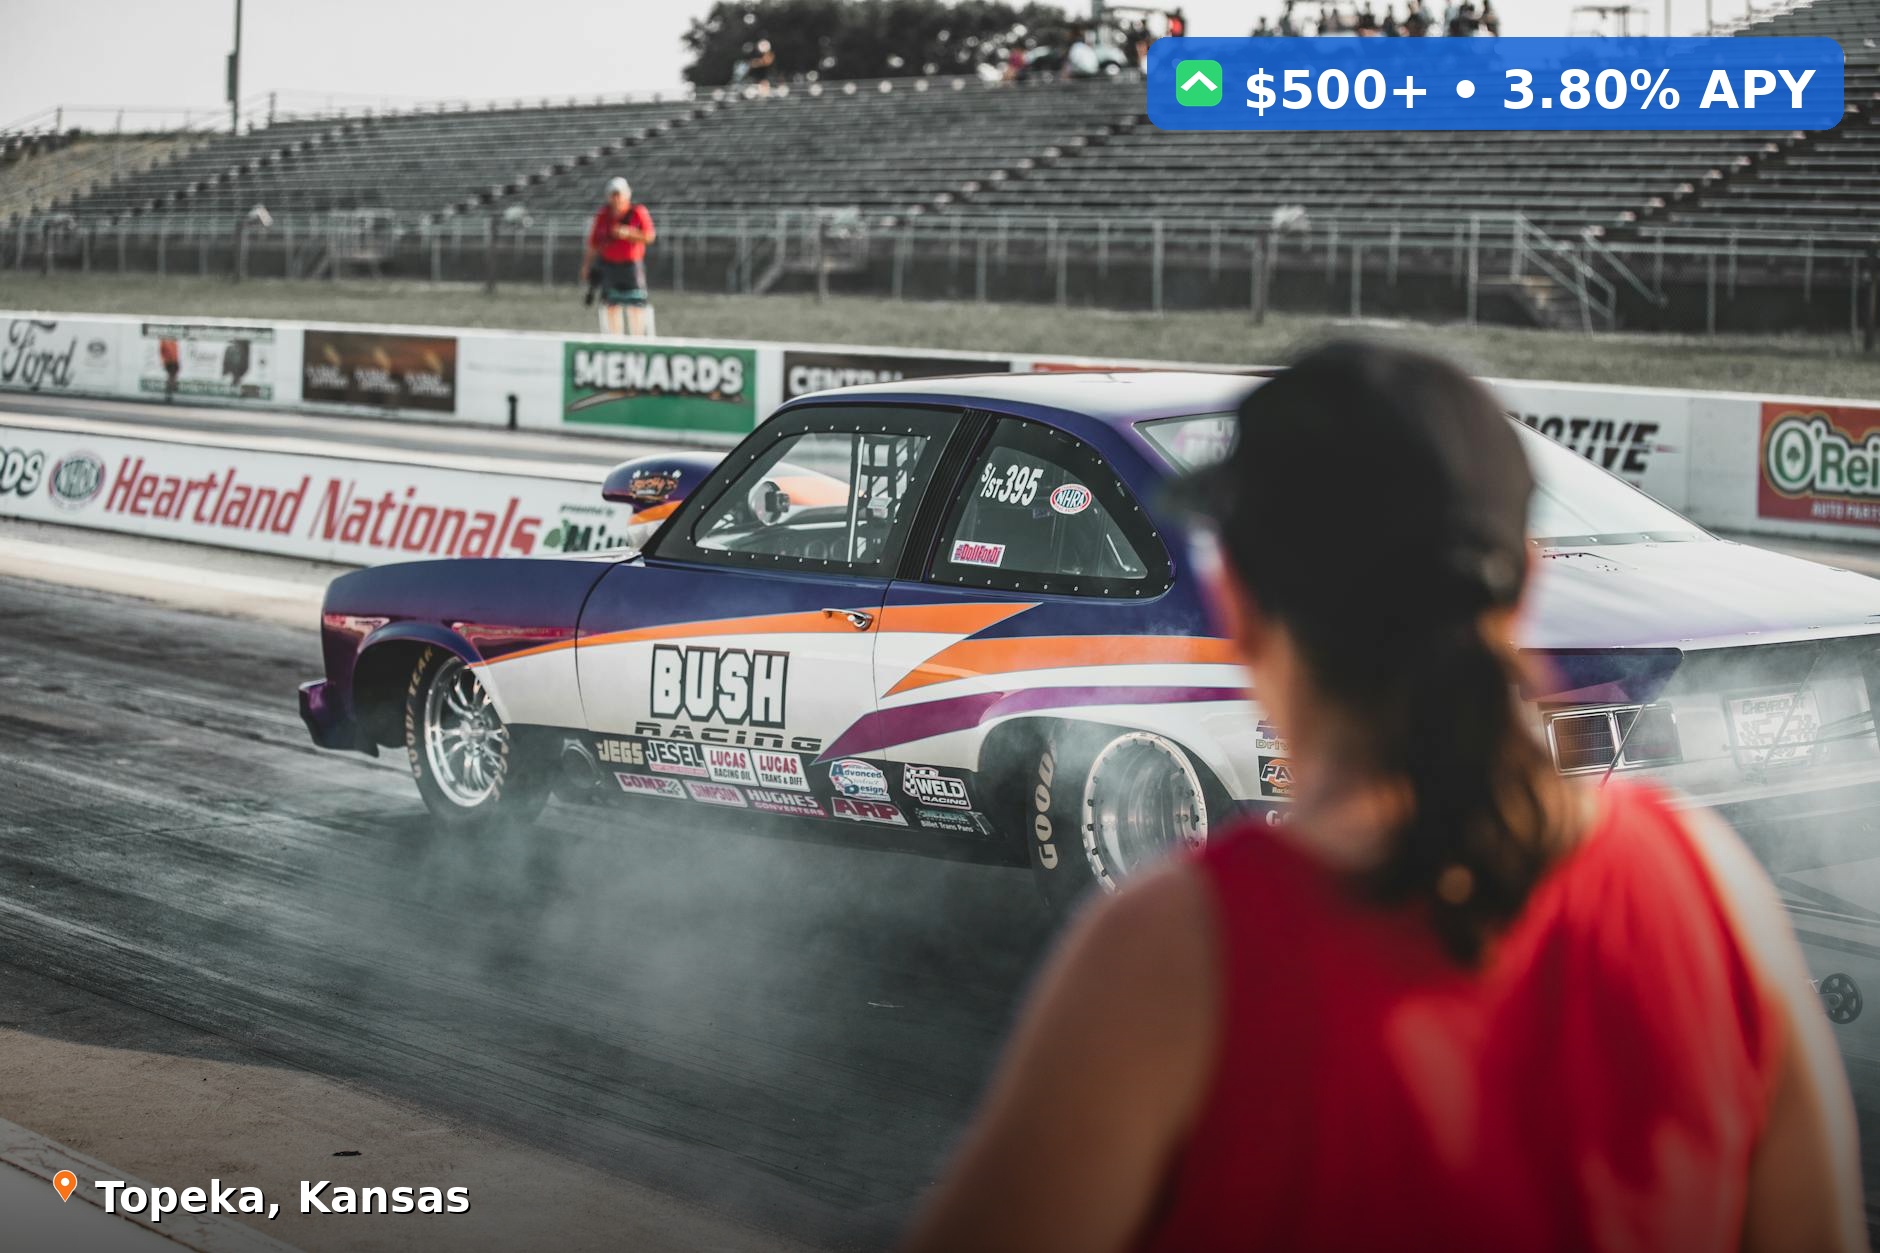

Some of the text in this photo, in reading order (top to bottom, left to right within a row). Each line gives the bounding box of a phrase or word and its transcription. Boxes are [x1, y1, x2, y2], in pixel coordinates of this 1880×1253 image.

[2, 319, 78, 391] Ford
[574, 350, 744, 396] MENARDS
[1507, 412, 1659, 444] OTIVE
[0, 446, 44, 498] DS
[997, 464, 1044, 507] 395
[104, 456, 542, 559] Heartland Nationals
[1056, 489, 1086, 509] NHRA
[1811, 502, 1845, 517] AUTO
[651, 643, 790, 730] BUSH
[634, 721, 822, 752] RACING
[596, 739, 645, 766] JEGS
[646, 741, 705, 768] JESEL
[709, 749, 747, 770] LUCAS
[713, 767, 739, 780] RACING
[740, 771, 752, 782] OIL
[758, 754, 798, 776] LUCAS
[831, 763, 884, 778] Advanced
[618, 774, 667, 790] COMP
[760, 772, 781, 785] TRANS
[789, 777, 804, 787] DIFF
[844, 784, 886, 797] Design
[915, 777, 965, 799] WELD
[691, 783, 740, 803] SIMPSON
[746, 788, 819, 809] HUGHES
[922, 795, 969, 806] RACING
[754, 801, 826, 817] CONVERTERS
[833, 798, 900, 821] ARP
